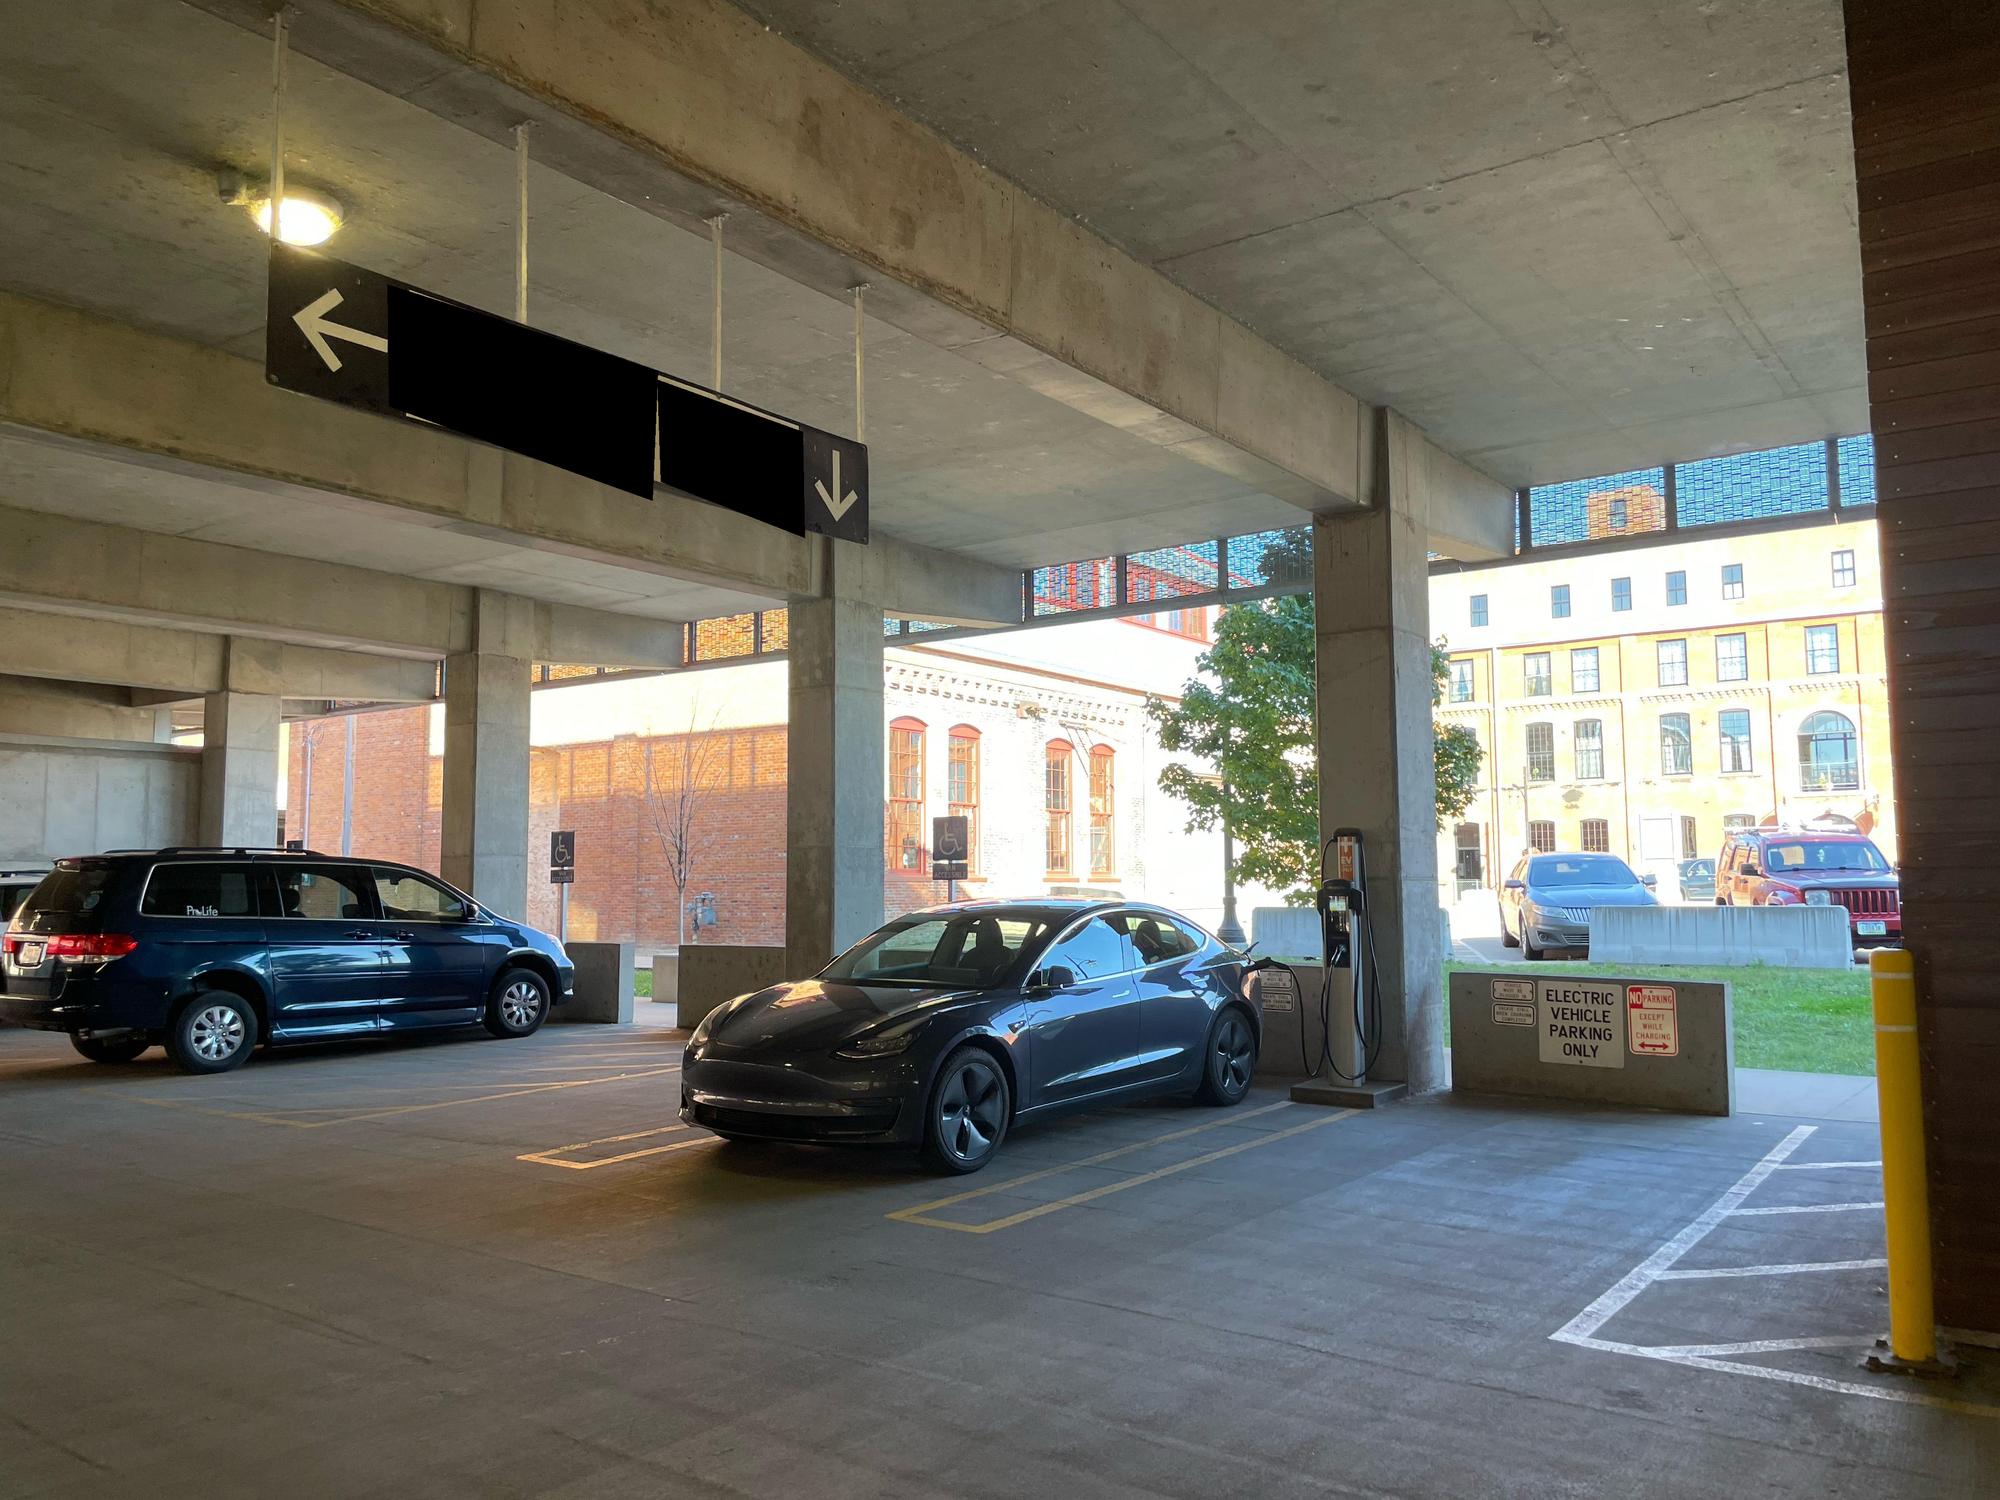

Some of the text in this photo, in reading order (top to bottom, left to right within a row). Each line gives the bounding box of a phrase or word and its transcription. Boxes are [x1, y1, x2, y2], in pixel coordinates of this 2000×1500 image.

[1340, 855, 1353, 865] EV
[1546, 989, 1614, 1006] ELECTRIC
[1630, 991, 1673, 1005] NO PARKING
[1550, 1006, 1611, 1024] VEHICLE
[1639, 1012, 1665, 1021] EXCEPT
[1549, 1024, 1613, 1042] PARKING
[1641, 1023, 1664, 1031] WHILE
[1635, 1032, 1671, 1041] CHARGING
[1562, 1043, 1599, 1058] ONLY
